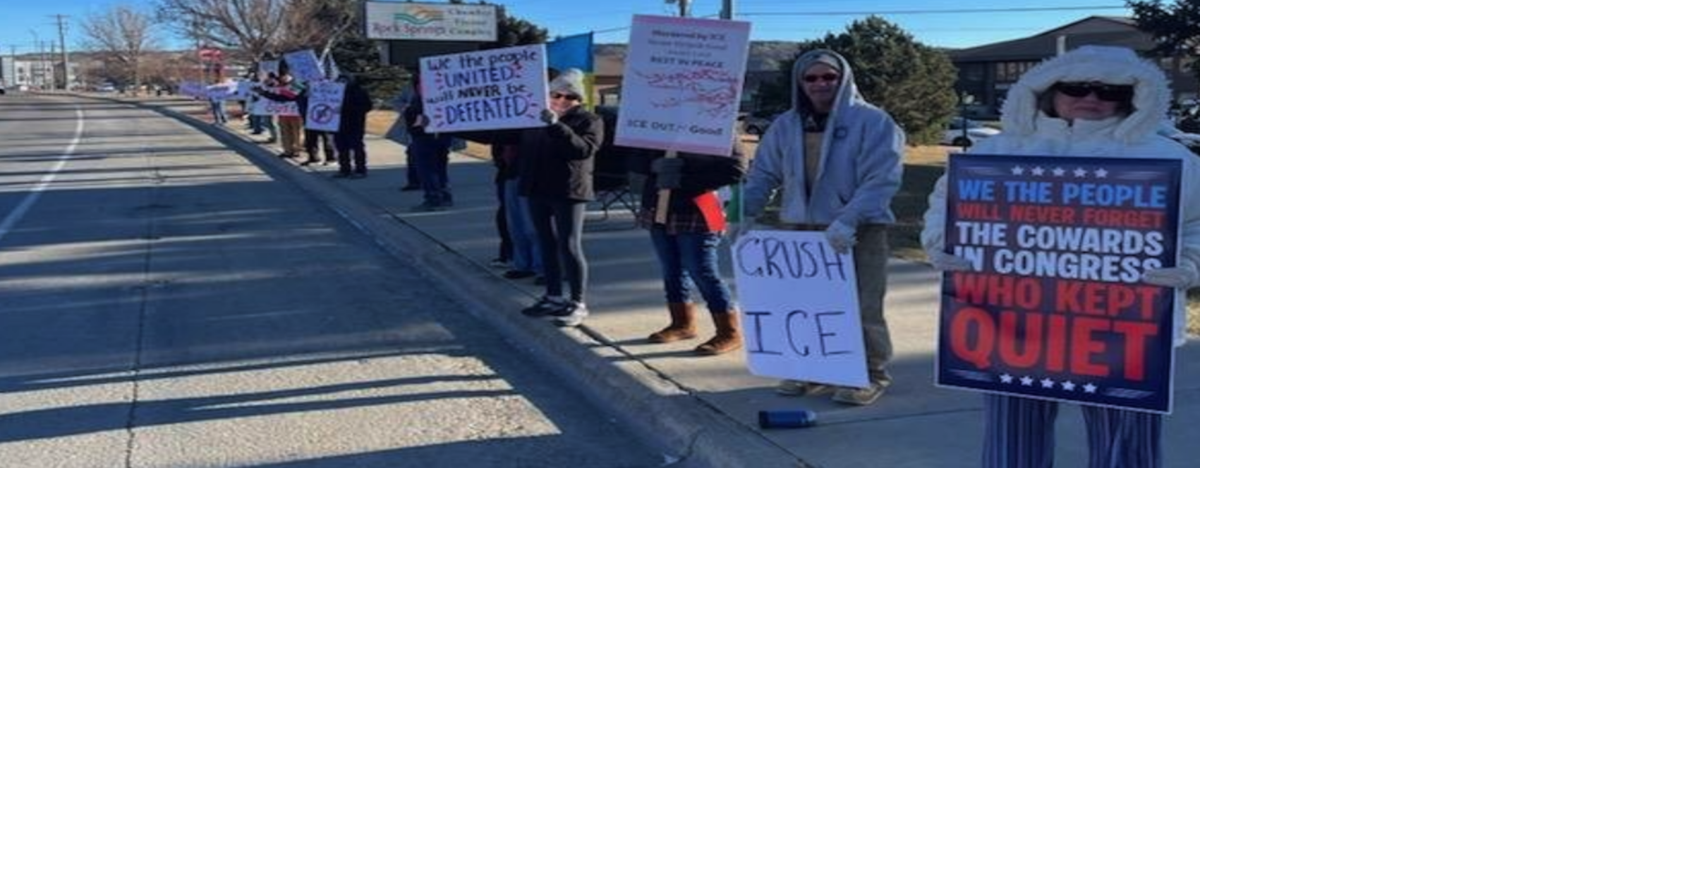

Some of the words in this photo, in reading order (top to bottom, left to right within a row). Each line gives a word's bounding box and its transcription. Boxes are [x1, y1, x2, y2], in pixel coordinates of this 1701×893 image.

[459, 53, 484, 68] the
[489, 49, 538, 68] people
[691, 60, 725, 68] PEACE
[444, 66, 514, 88] UNITED
[428, 90, 454, 104] will
[457, 84, 500, 101] NEVER
[507, 82, 528, 94] be
[445, 94, 529, 125] DEFEATED
[957, 179, 997, 202] WE
[1004, 181, 1053, 204] THE
[1062, 183, 1167, 208] PEOPLE
[956, 203, 1001, 221] WILL
[1009, 204, 1075, 224] NEVER
[1083, 207, 1165, 228] FORGET
[956, 221, 1007, 247] THE
[1017, 225, 1164, 256] COWARDS
[736, 237, 847, 281] CRUSH
[954, 273, 1042, 309] WHO
[1056, 281, 1161, 319] KEPT
[745, 310, 854, 357] ICE
[951, 306, 1158, 381] QUIET
